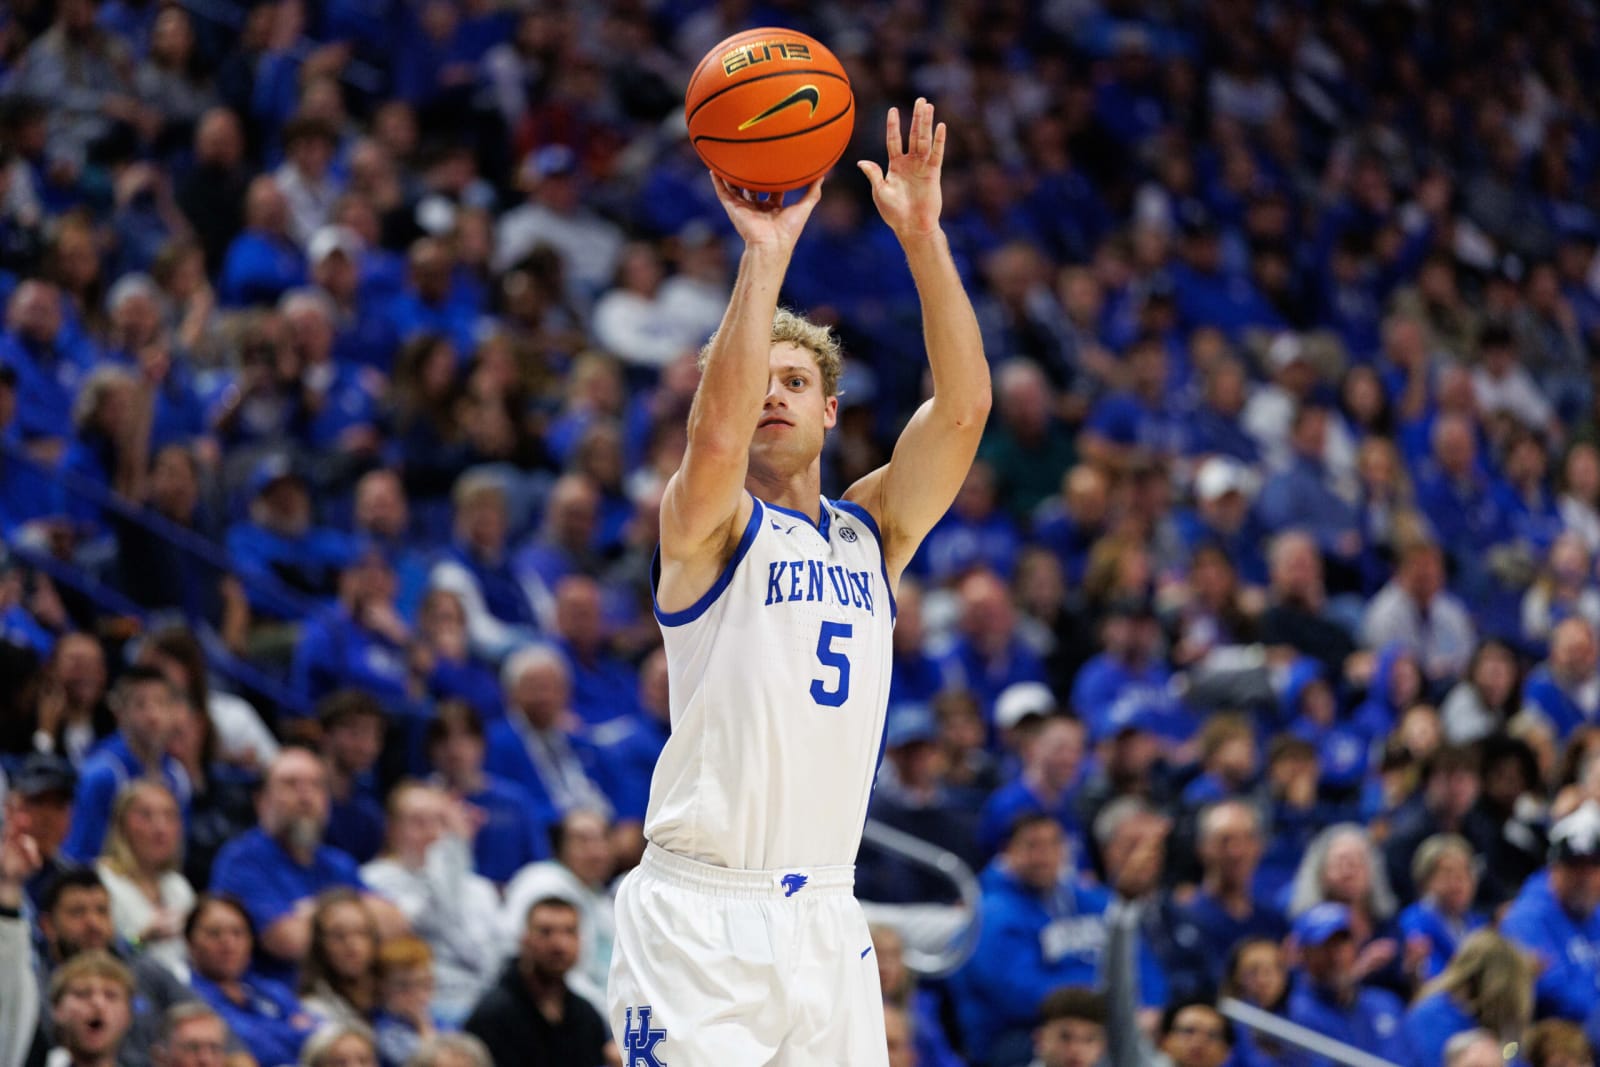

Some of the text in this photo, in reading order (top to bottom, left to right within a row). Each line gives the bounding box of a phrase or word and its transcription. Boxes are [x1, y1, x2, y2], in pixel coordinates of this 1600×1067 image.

[723, 43, 811, 76] ELITE
[765, 560, 874, 616] KENUCK
[809, 621, 852, 707] 5
